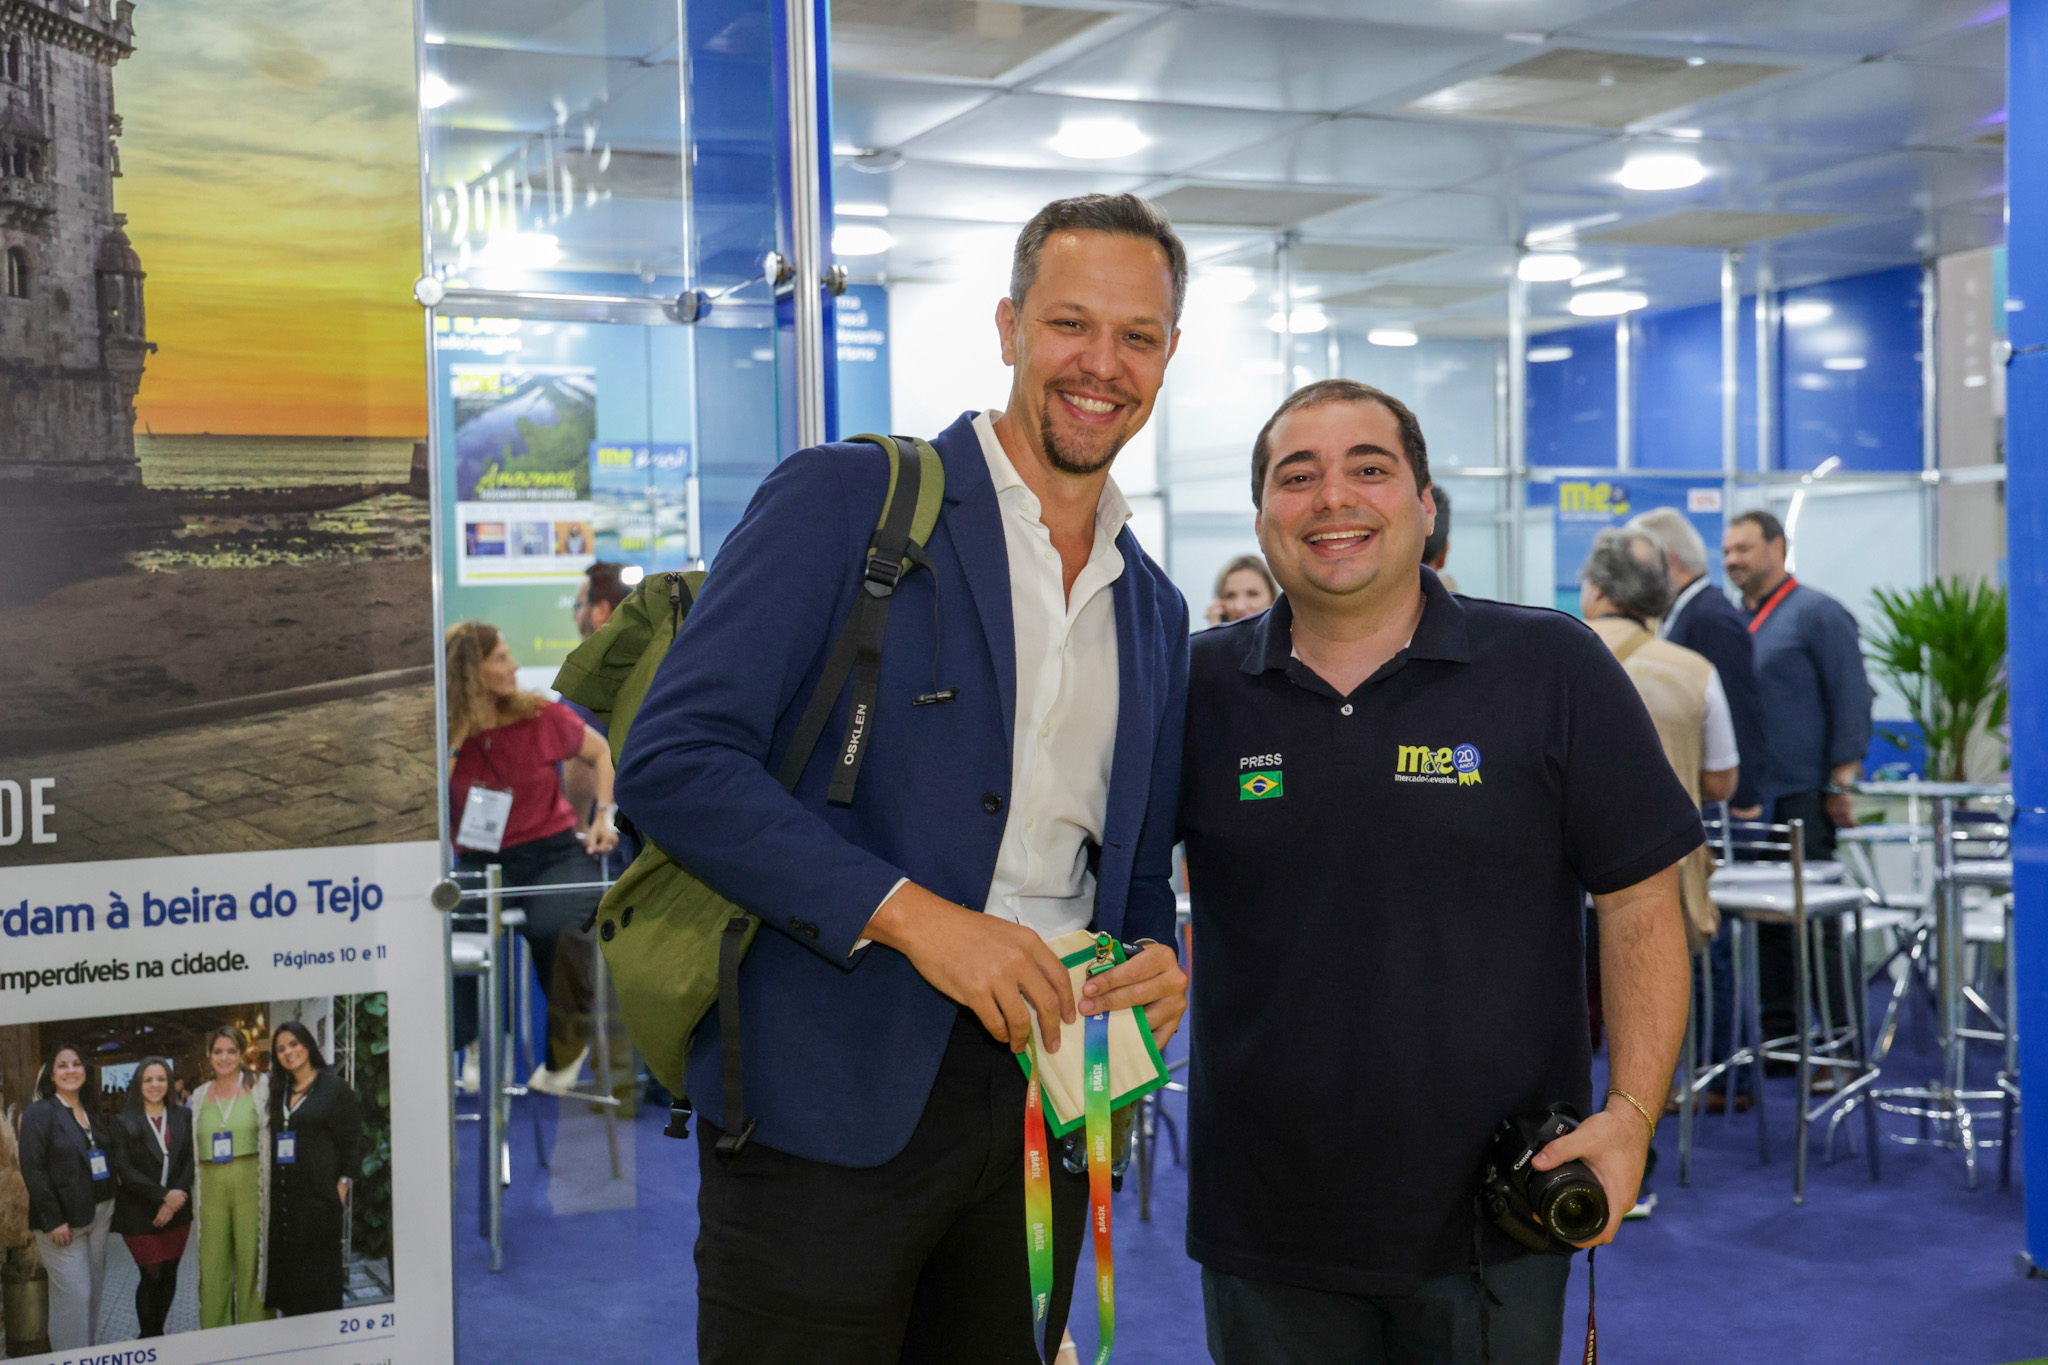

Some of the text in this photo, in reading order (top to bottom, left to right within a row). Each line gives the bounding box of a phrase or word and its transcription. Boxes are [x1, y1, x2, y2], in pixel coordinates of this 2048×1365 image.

[844, 704, 867, 765] OSKLEN
[1240, 753, 1283, 769] PRESS
[1457, 749, 1474, 763] 20
[0, 876, 383, 937] dam à beira do Tejo
[273, 945, 386, 970] Páginas 10 e 11
[0, 950, 249, 995] mperdíveis na cidade.
[1555, 1123, 1565, 1135] EOS
[1513, 1150, 1533, 1170] Canon
[340, 1313, 395, 1334] 20 e 21
